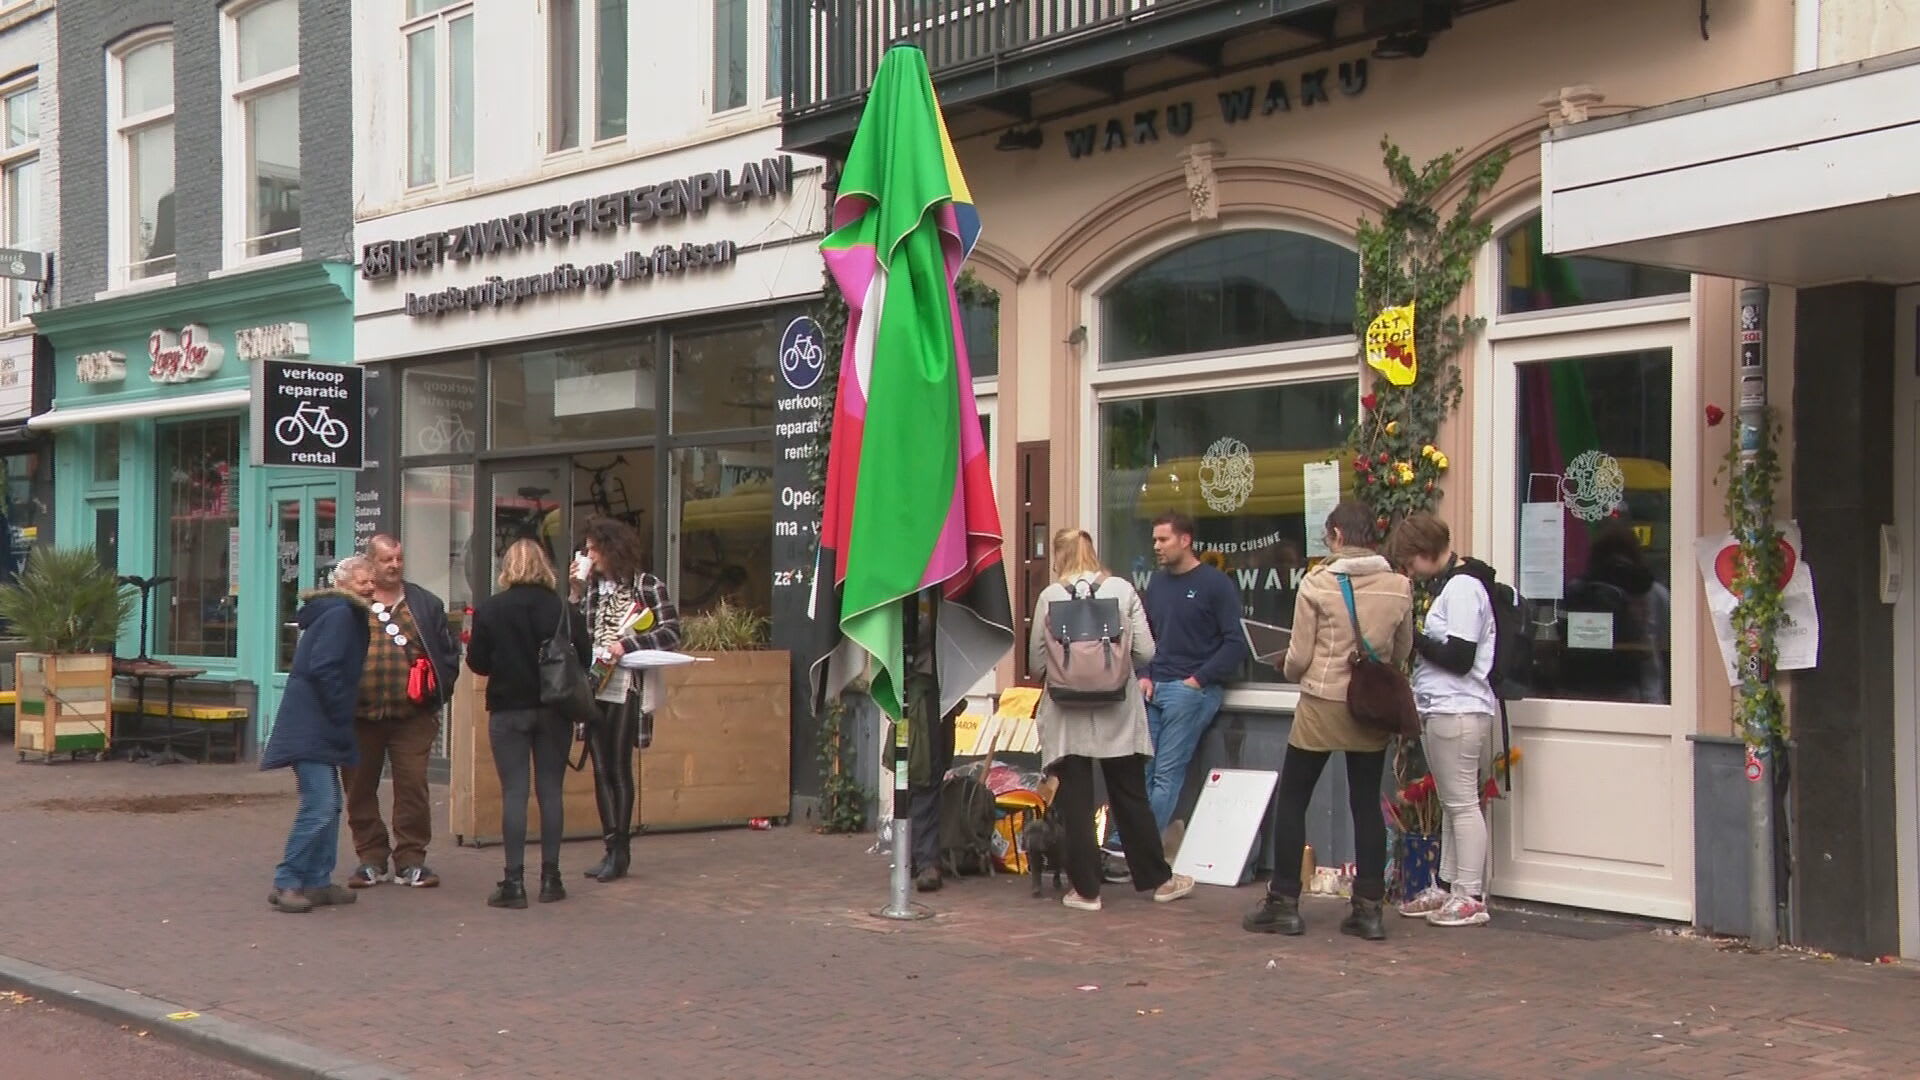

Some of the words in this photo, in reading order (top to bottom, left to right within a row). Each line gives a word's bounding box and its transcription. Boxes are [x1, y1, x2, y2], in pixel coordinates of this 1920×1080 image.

[1064, 101, 1193, 160] WAKU
[1217, 58, 1368, 125] WAKU
[395, 231, 444, 273] HET
[465, 263, 583, 311] prijsgarantie
[584, 263, 614, 289] op
[613, 251, 652, 280] alle
[651, 240, 737, 275] fietsen
[282, 368, 344, 385] verkoop
[278, 385, 348, 399] reparatie
[776, 420, 821, 439] reparat
[291, 452, 336, 464] rental
[356, 521, 376, 533] Sparta
[775, 521, 798, 536] ma
[1206, 542, 1237, 553] BASED
[1240, 531, 1280, 552] CUISINE
